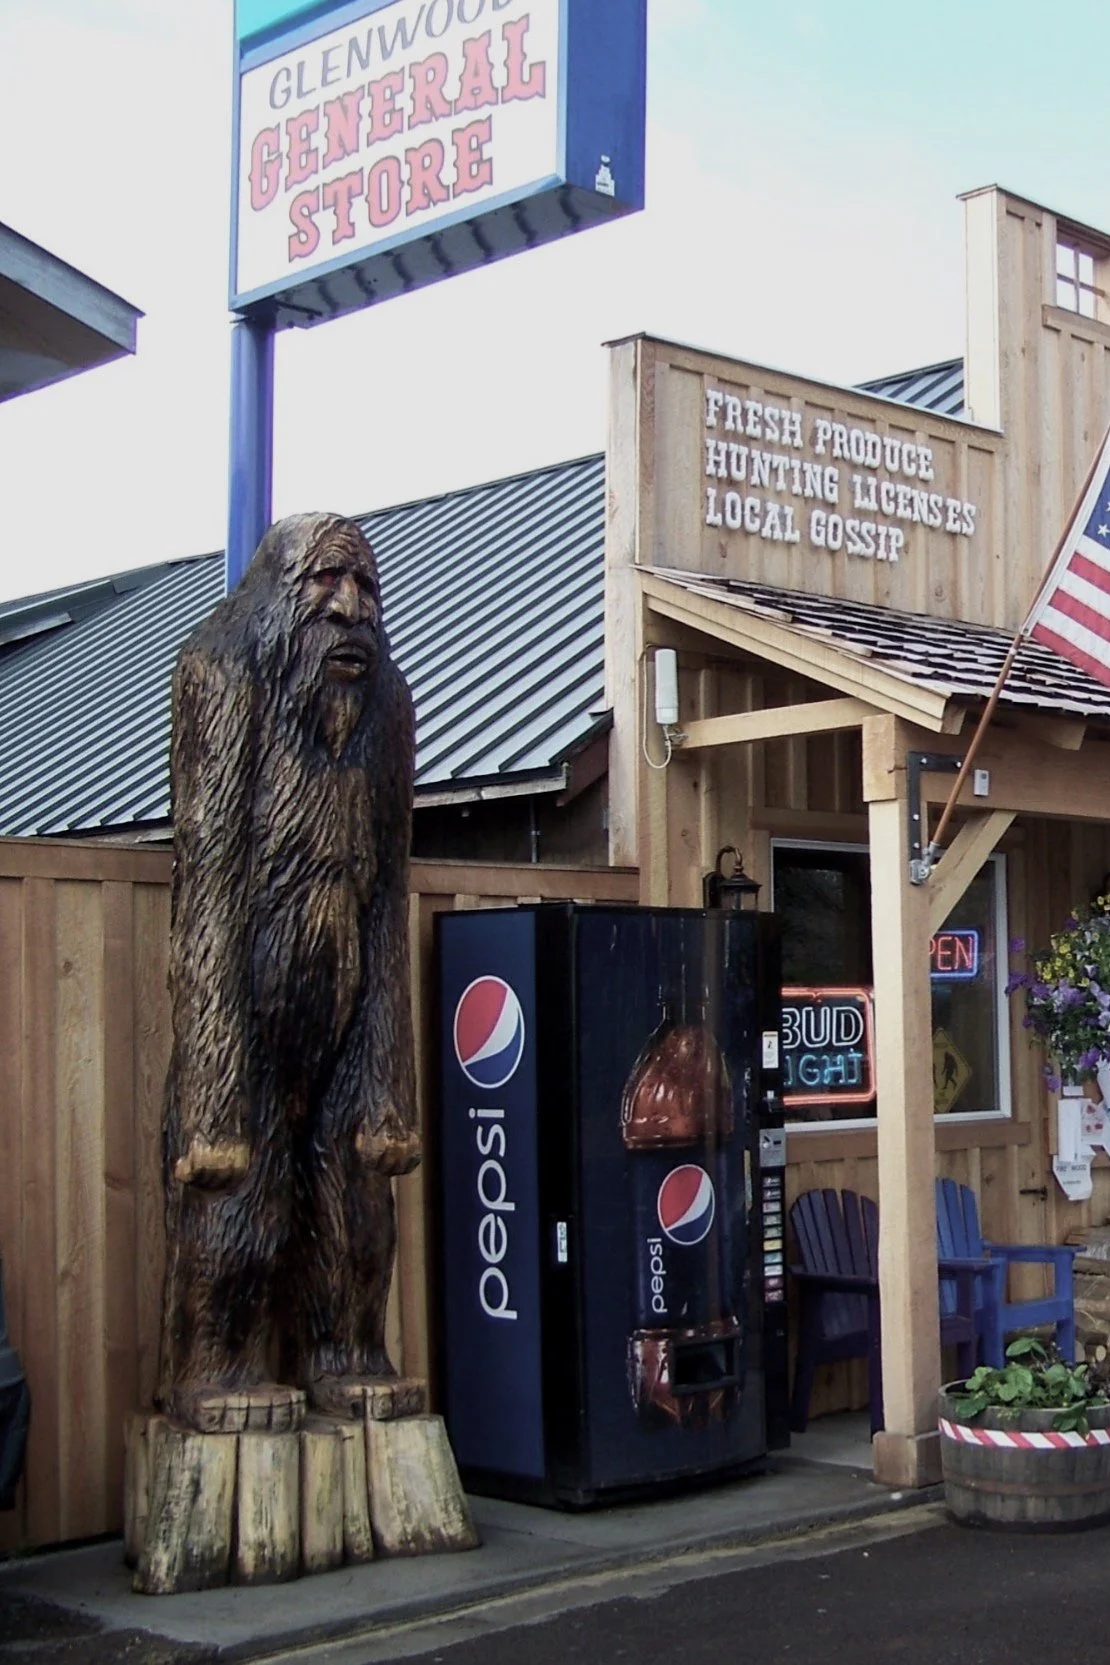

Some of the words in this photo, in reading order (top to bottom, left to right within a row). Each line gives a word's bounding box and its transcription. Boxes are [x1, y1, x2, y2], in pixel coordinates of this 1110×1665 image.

[269, 0, 512, 110] GLENWOO
[249, 13, 546, 211] GENERAL
[288, 114, 493, 263] STORE
[705, 388, 803, 449] FRESH
[815, 418, 934, 481] PRODUCE
[705, 438, 839, 505] HUNTING
[852, 474, 977, 536] LICENSES
[705, 487, 801, 543] LOCAL
[810, 509, 904, 563] GOSSIP
[782, 1006, 864, 1049] BUD
[468, 1107, 518, 1320] pepsi
[646, 1236, 669, 1314] pepsi
